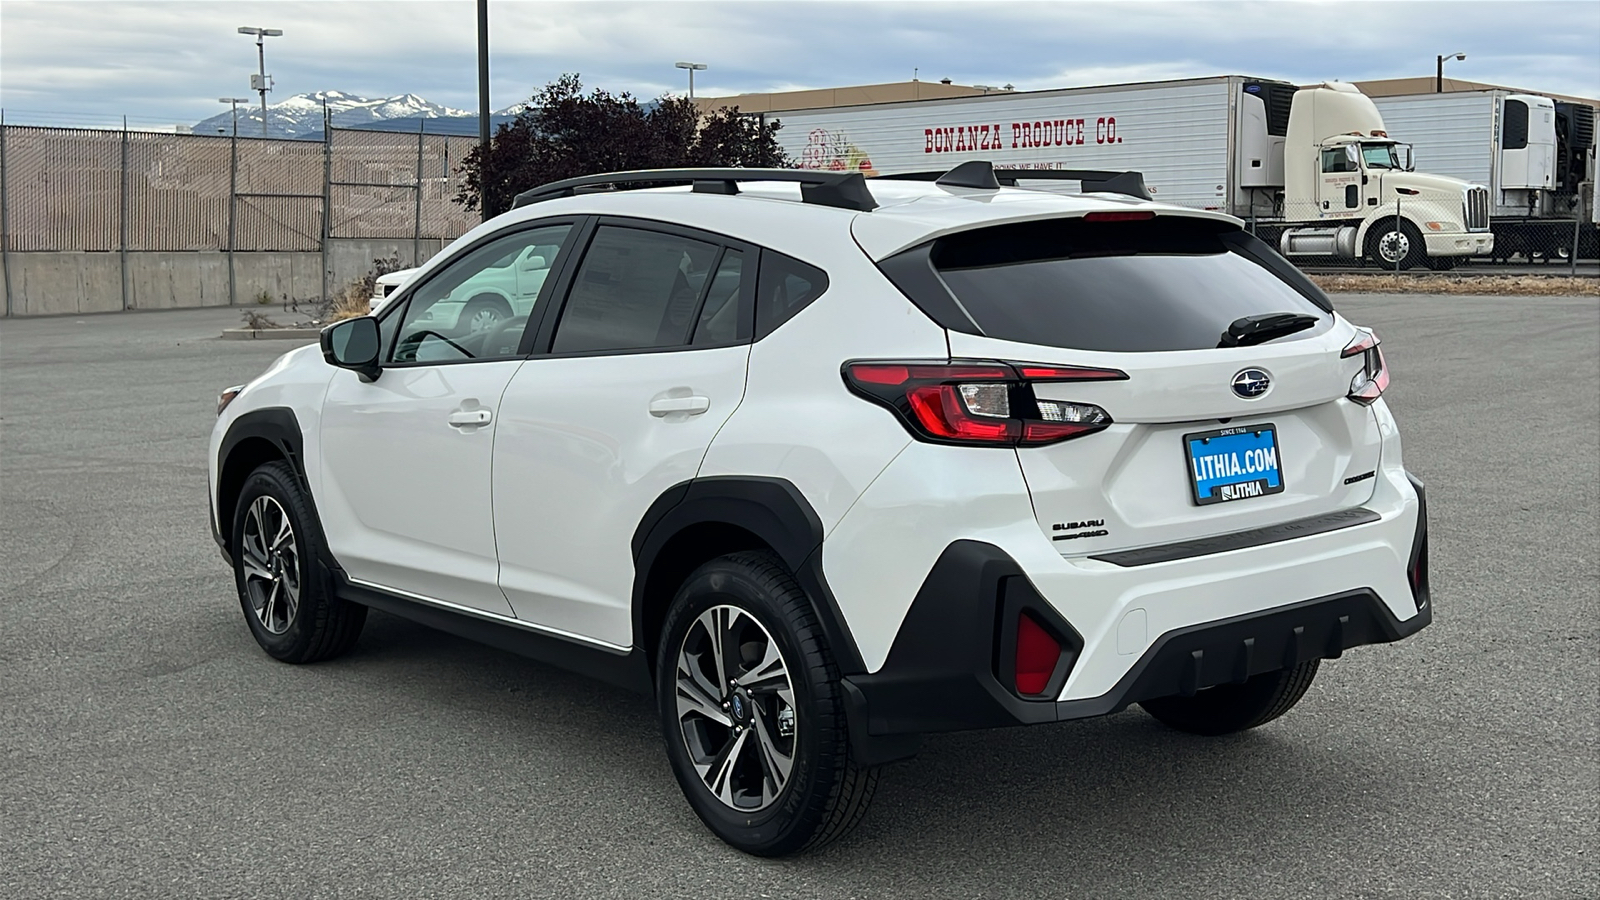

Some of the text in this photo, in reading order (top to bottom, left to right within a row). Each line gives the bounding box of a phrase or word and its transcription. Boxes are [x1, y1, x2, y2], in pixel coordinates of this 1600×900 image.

[925, 116, 1123, 153] BONANZA PRODUCE CO.
[1034, 162, 1053, 170] HAVE
[1192, 446, 1278, 482] LITHIA.COM
[1231, 482, 1264, 498] LITHIA
[1052, 519, 1104, 530] SUBARU
[1078, 530, 1109, 538] AWD
